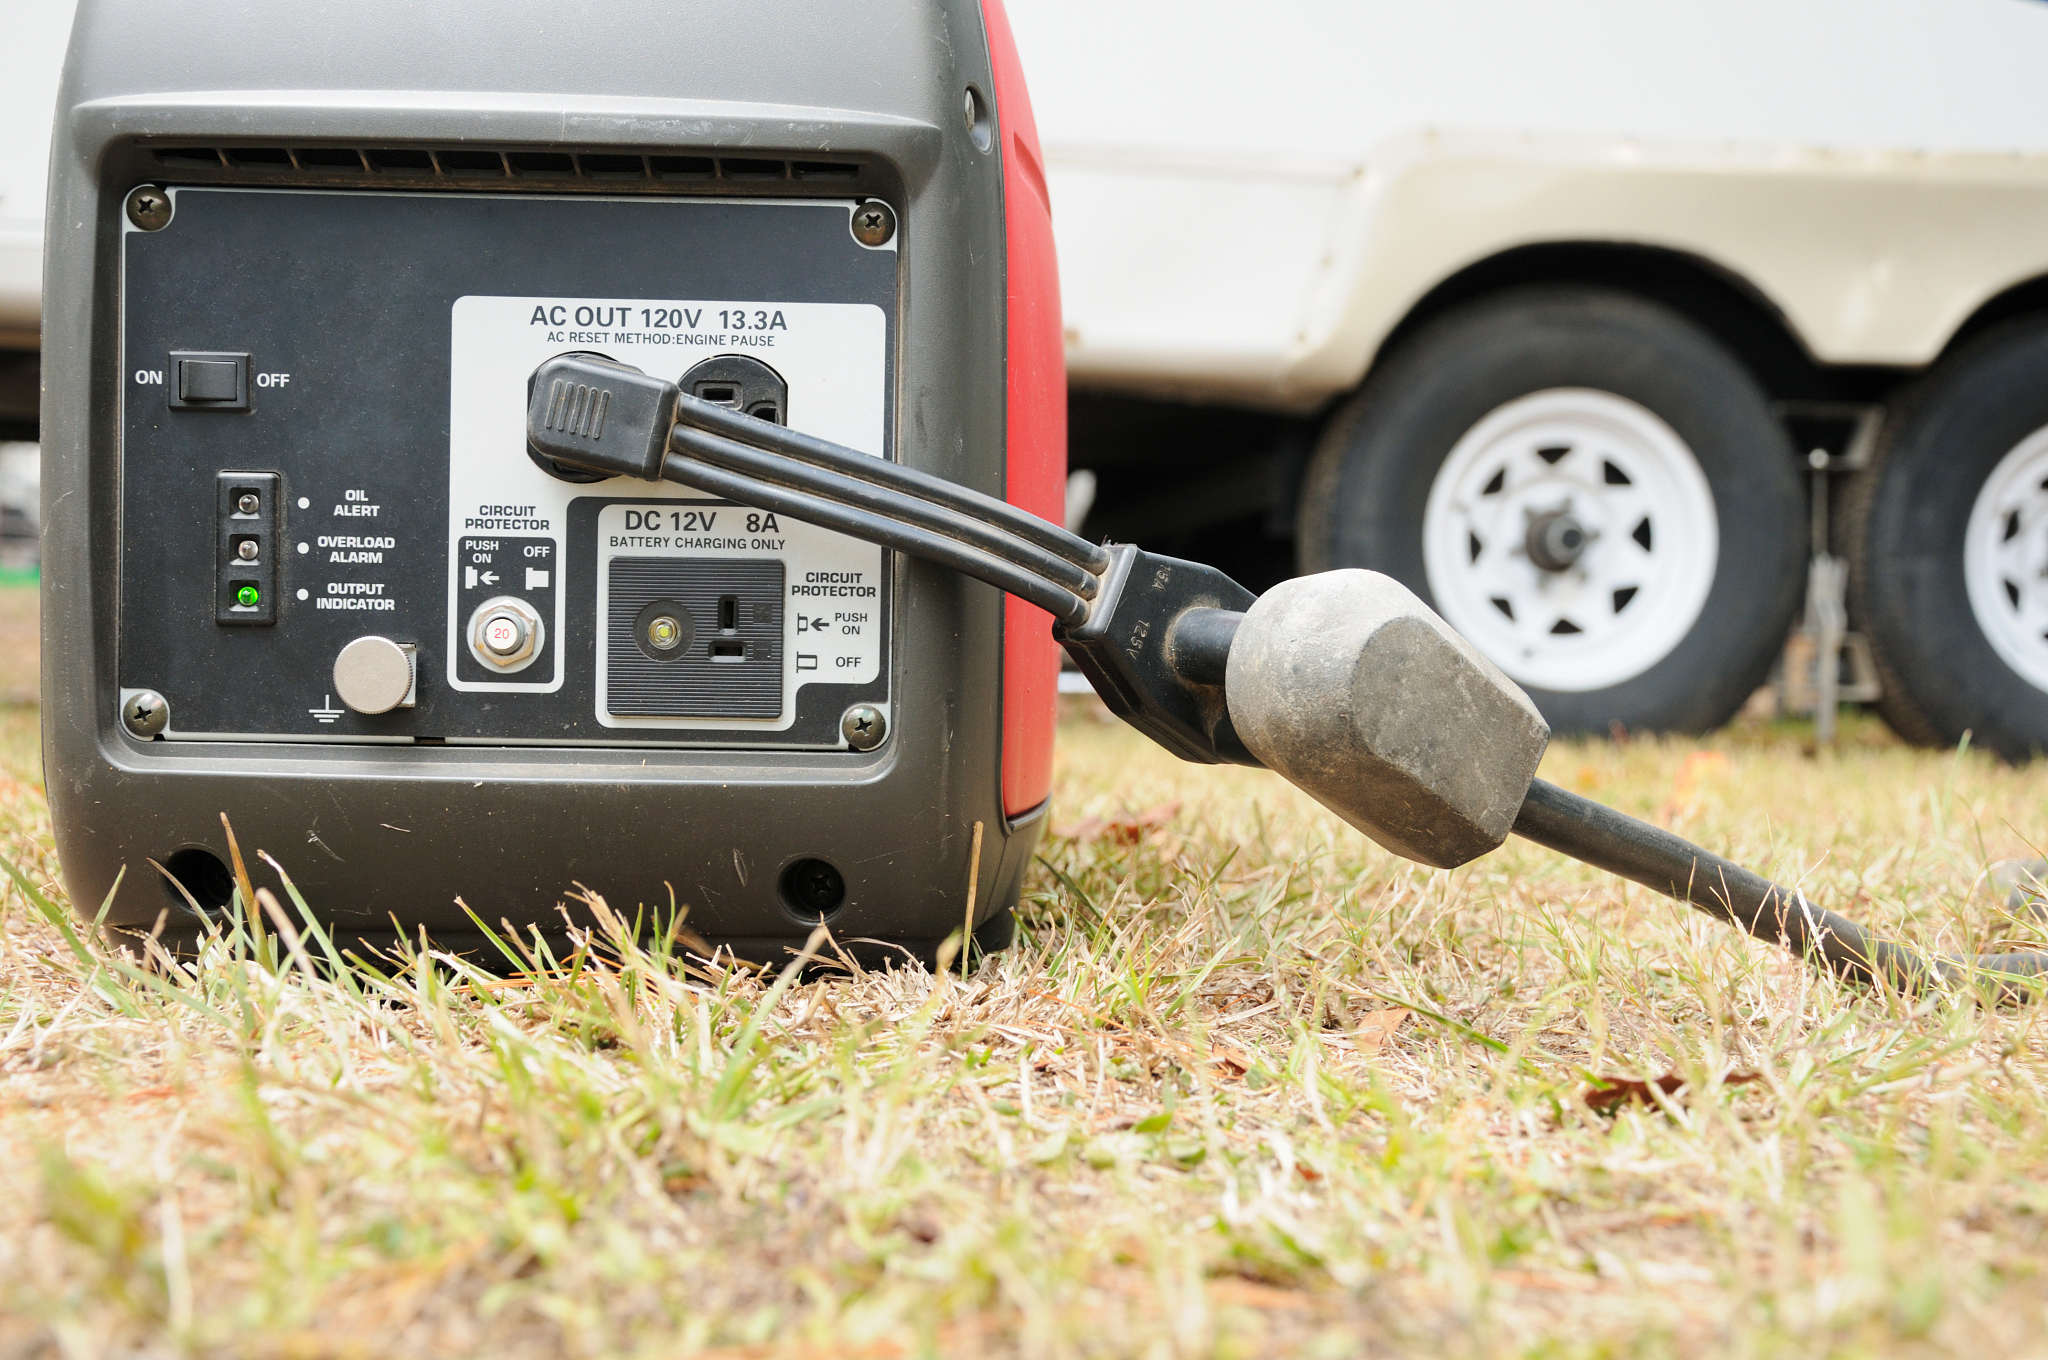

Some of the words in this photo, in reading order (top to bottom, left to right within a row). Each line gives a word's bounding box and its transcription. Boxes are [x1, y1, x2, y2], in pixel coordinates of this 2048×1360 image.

[530, 305, 567, 327] AC
[574, 306, 632, 328] OUT
[641, 308, 703, 329] 120V
[718, 309, 788, 331] 13.3A
[547, 331, 565, 343] AC
[569, 331, 610, 344] RESET
[731, 334, 775, 347] PAUSE
[135, 369, 163, 385] ON
[256, 372, 290, 388] OFF
[345, 489, 369, 502] OIL
[333, 504, 381, 517] ALERT
[479, 504, 537, 517] CIRCUIT
[465, 518, 550, 531] PROTECTOR
[625, 510, 661, 531] DC
[670, 511, 717, 532] 12V
[746, 512, 780, 532] 8A
[317, 535, 396, 549] OVERLOAD
[465, 539, 499, 551] PUSH
[610, 536, 671, 548] BATTERY
[674, 537, 747, 550] CHARGING
[751, 538, 786, 550] ONLY
[329, 551, 383, 564] ALARM
[472, 552, 492, 564] ON
[523, 545, 551, 558] OFF
[805, 571, 863, 584] CIRCUIT
[1152, 565, 1172, 591] 15A
[327, 582, 385, 595] OUTPUT
[791, 585, 877, 598] PROTECTOR
[316, 597, 395, 611] INDICATOR
[834, 612, 868, 623] PUSH
[494, 627, 510, 640] 20
[841, 625, 861, 635] ON
[1126, 620, 1150, 660] 125V
[835, 656, 862, 668] OFF
